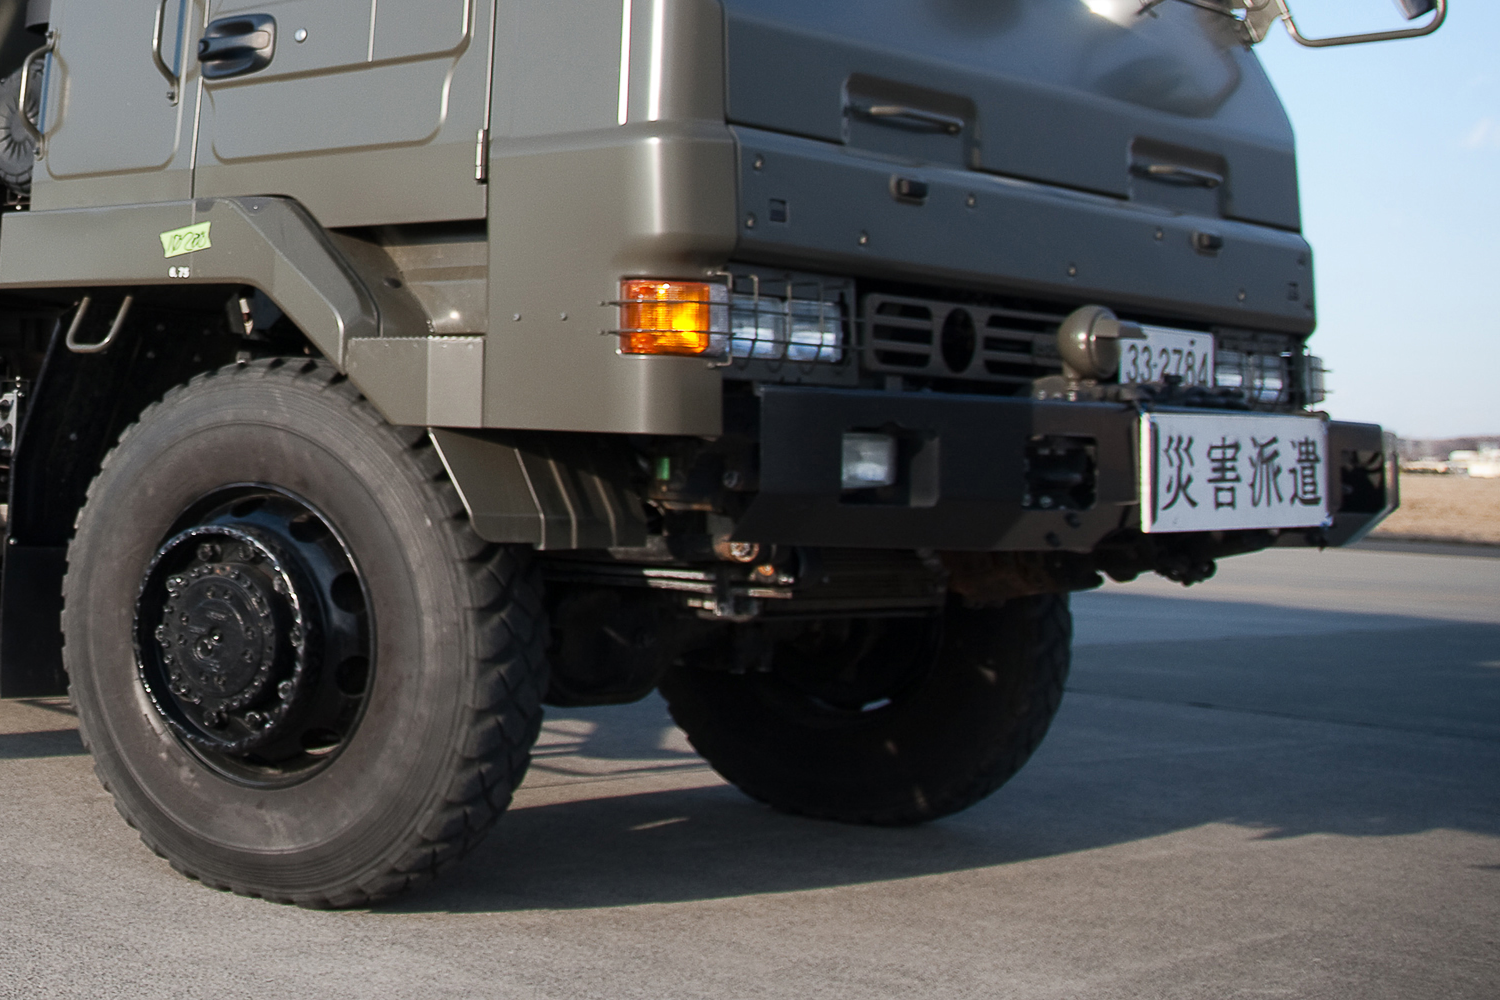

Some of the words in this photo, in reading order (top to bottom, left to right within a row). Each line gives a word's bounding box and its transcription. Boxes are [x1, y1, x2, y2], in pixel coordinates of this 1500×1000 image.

[1126, 344, 1208, 386] 33-2784
[1161, 434, 1322, 511] 災害派遣
